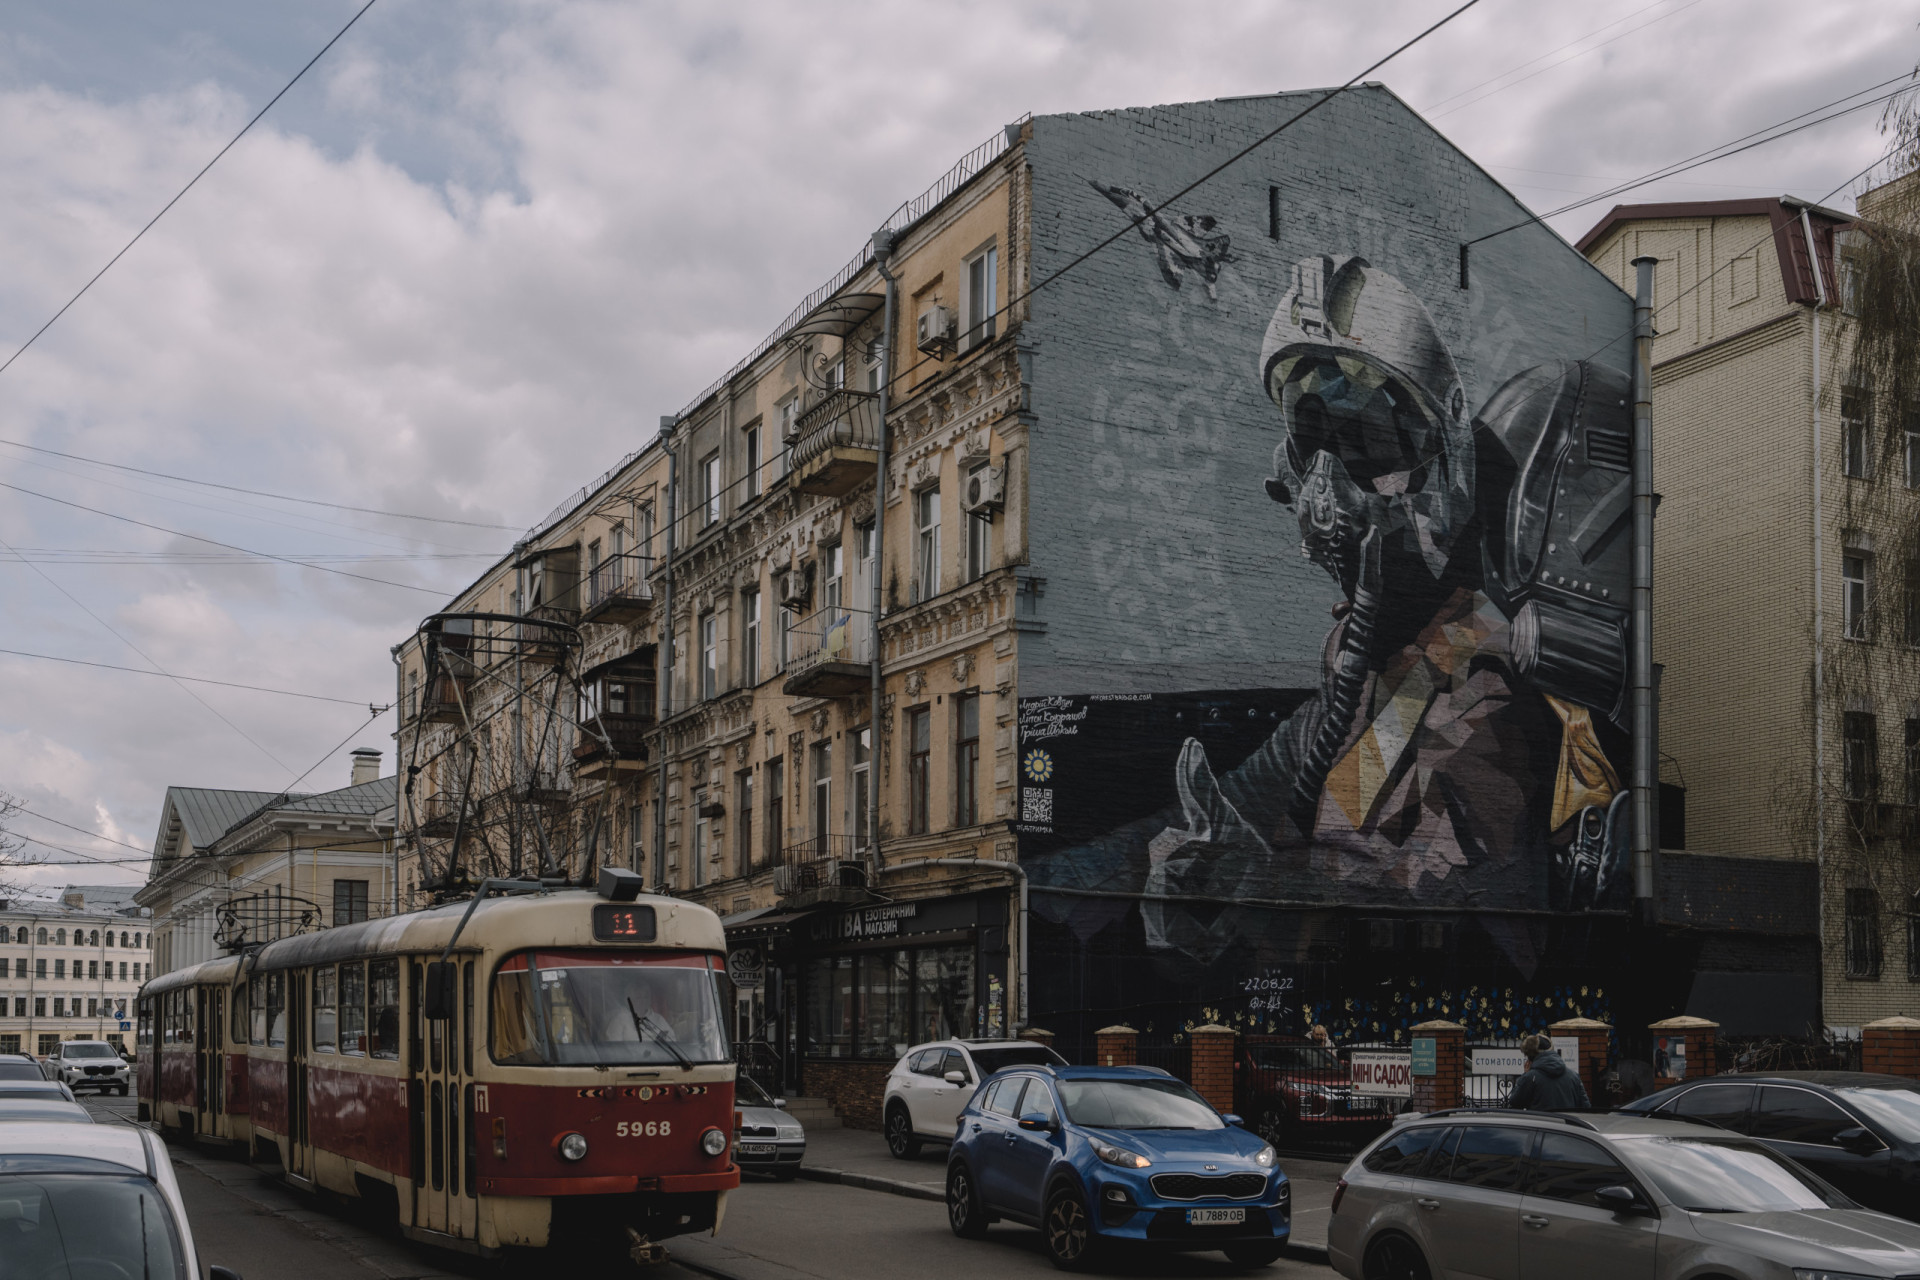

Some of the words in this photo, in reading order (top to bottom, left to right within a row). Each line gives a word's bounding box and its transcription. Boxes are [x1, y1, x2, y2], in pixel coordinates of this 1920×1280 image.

[865, 903, 916, 922] ЕЗОТЕРИЧНИЙ
[612, 913, 638, 935] 11
[864, 920, 898, 935] МАГАЗИН
[1353, 1063, 1372, 1084] МІНІ
[1374, 1064, 1410, 1088] САДОК
[616, 1121, 671, 1137] 5968
[1206, 1211, 1228, 1221] 7889
